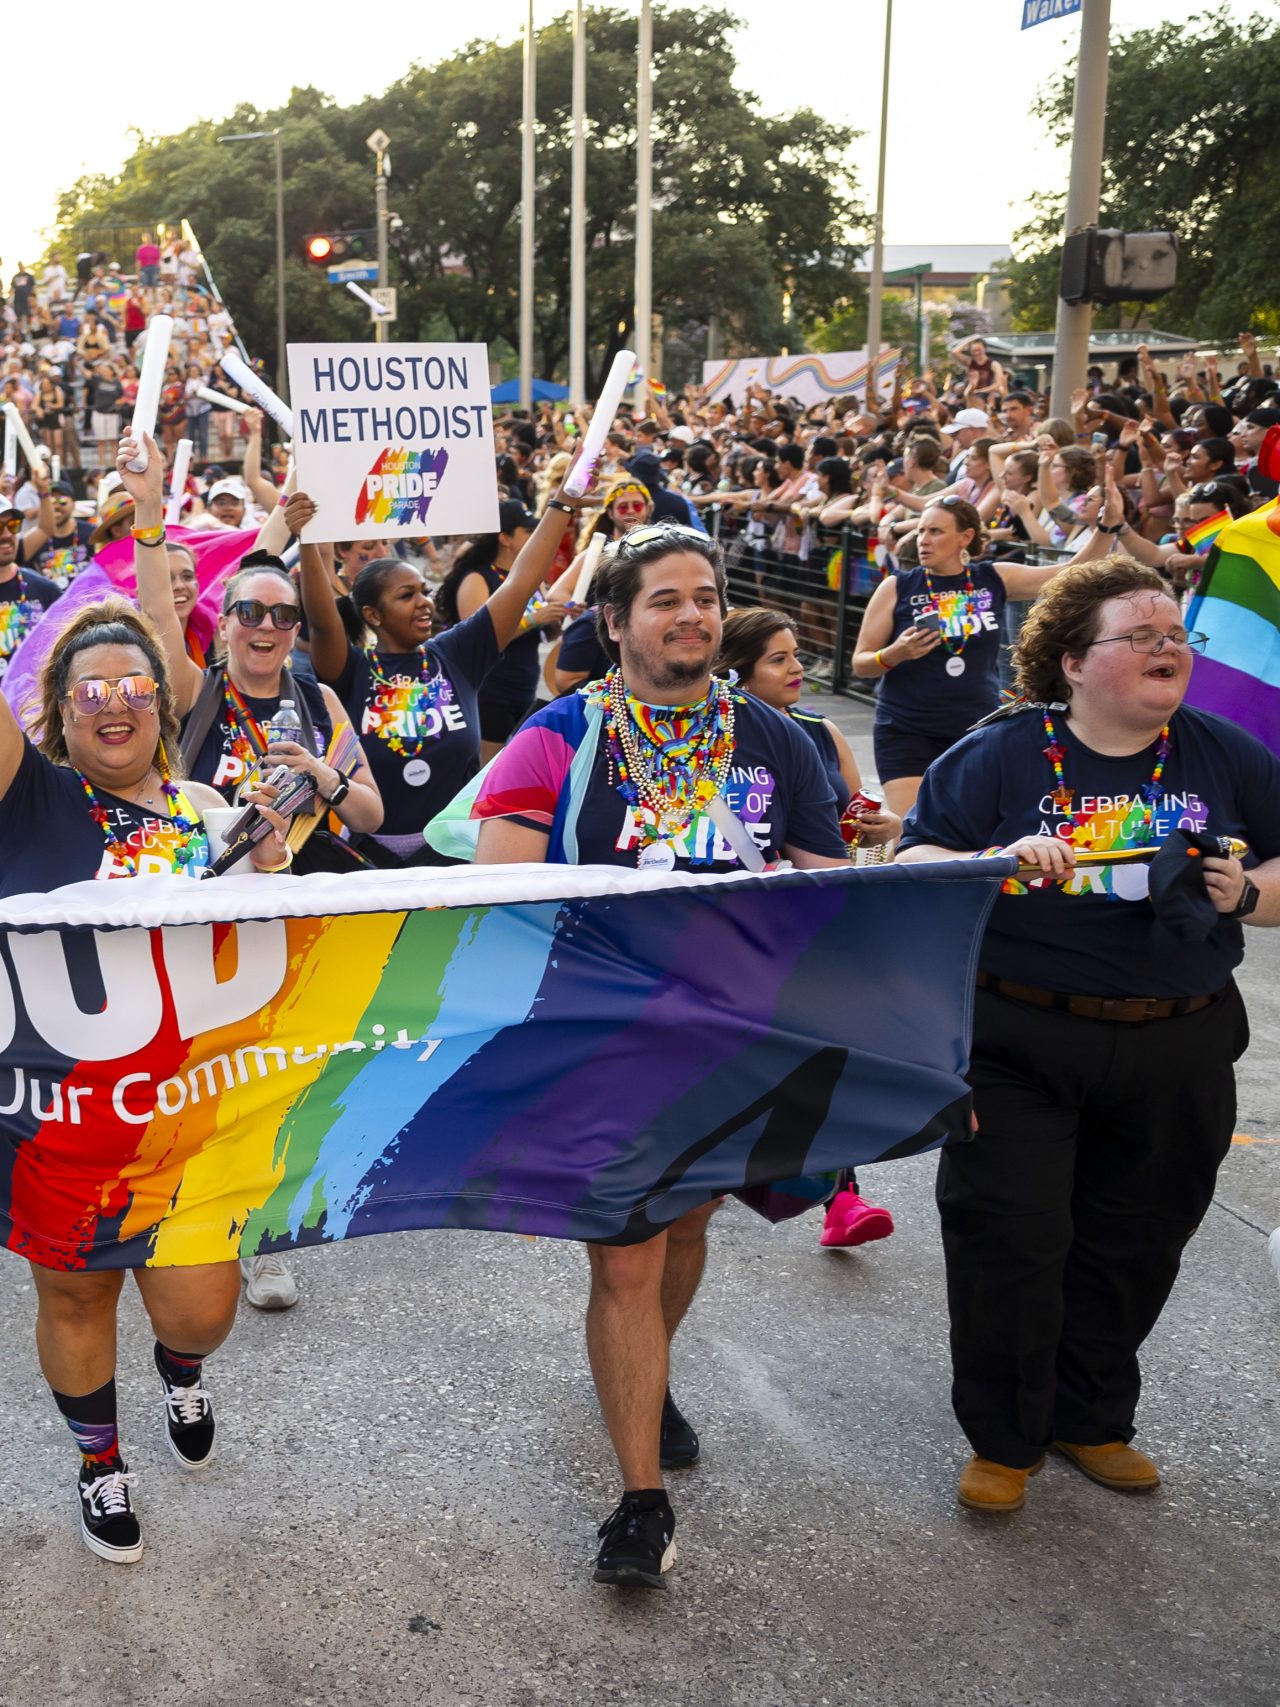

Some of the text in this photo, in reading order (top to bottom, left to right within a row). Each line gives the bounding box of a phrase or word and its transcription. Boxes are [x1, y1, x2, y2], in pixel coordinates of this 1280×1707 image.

[314, 356, 468, 392] HOUSTON
[300, 405, 487, 443] METHODIST
[381, 461, 420, 471] HOUSTON
[367, 472, 437, 500] PRIDE
[389, 501, 420, 510] PARADE
[361, 704, 467, 739] PRIDE
